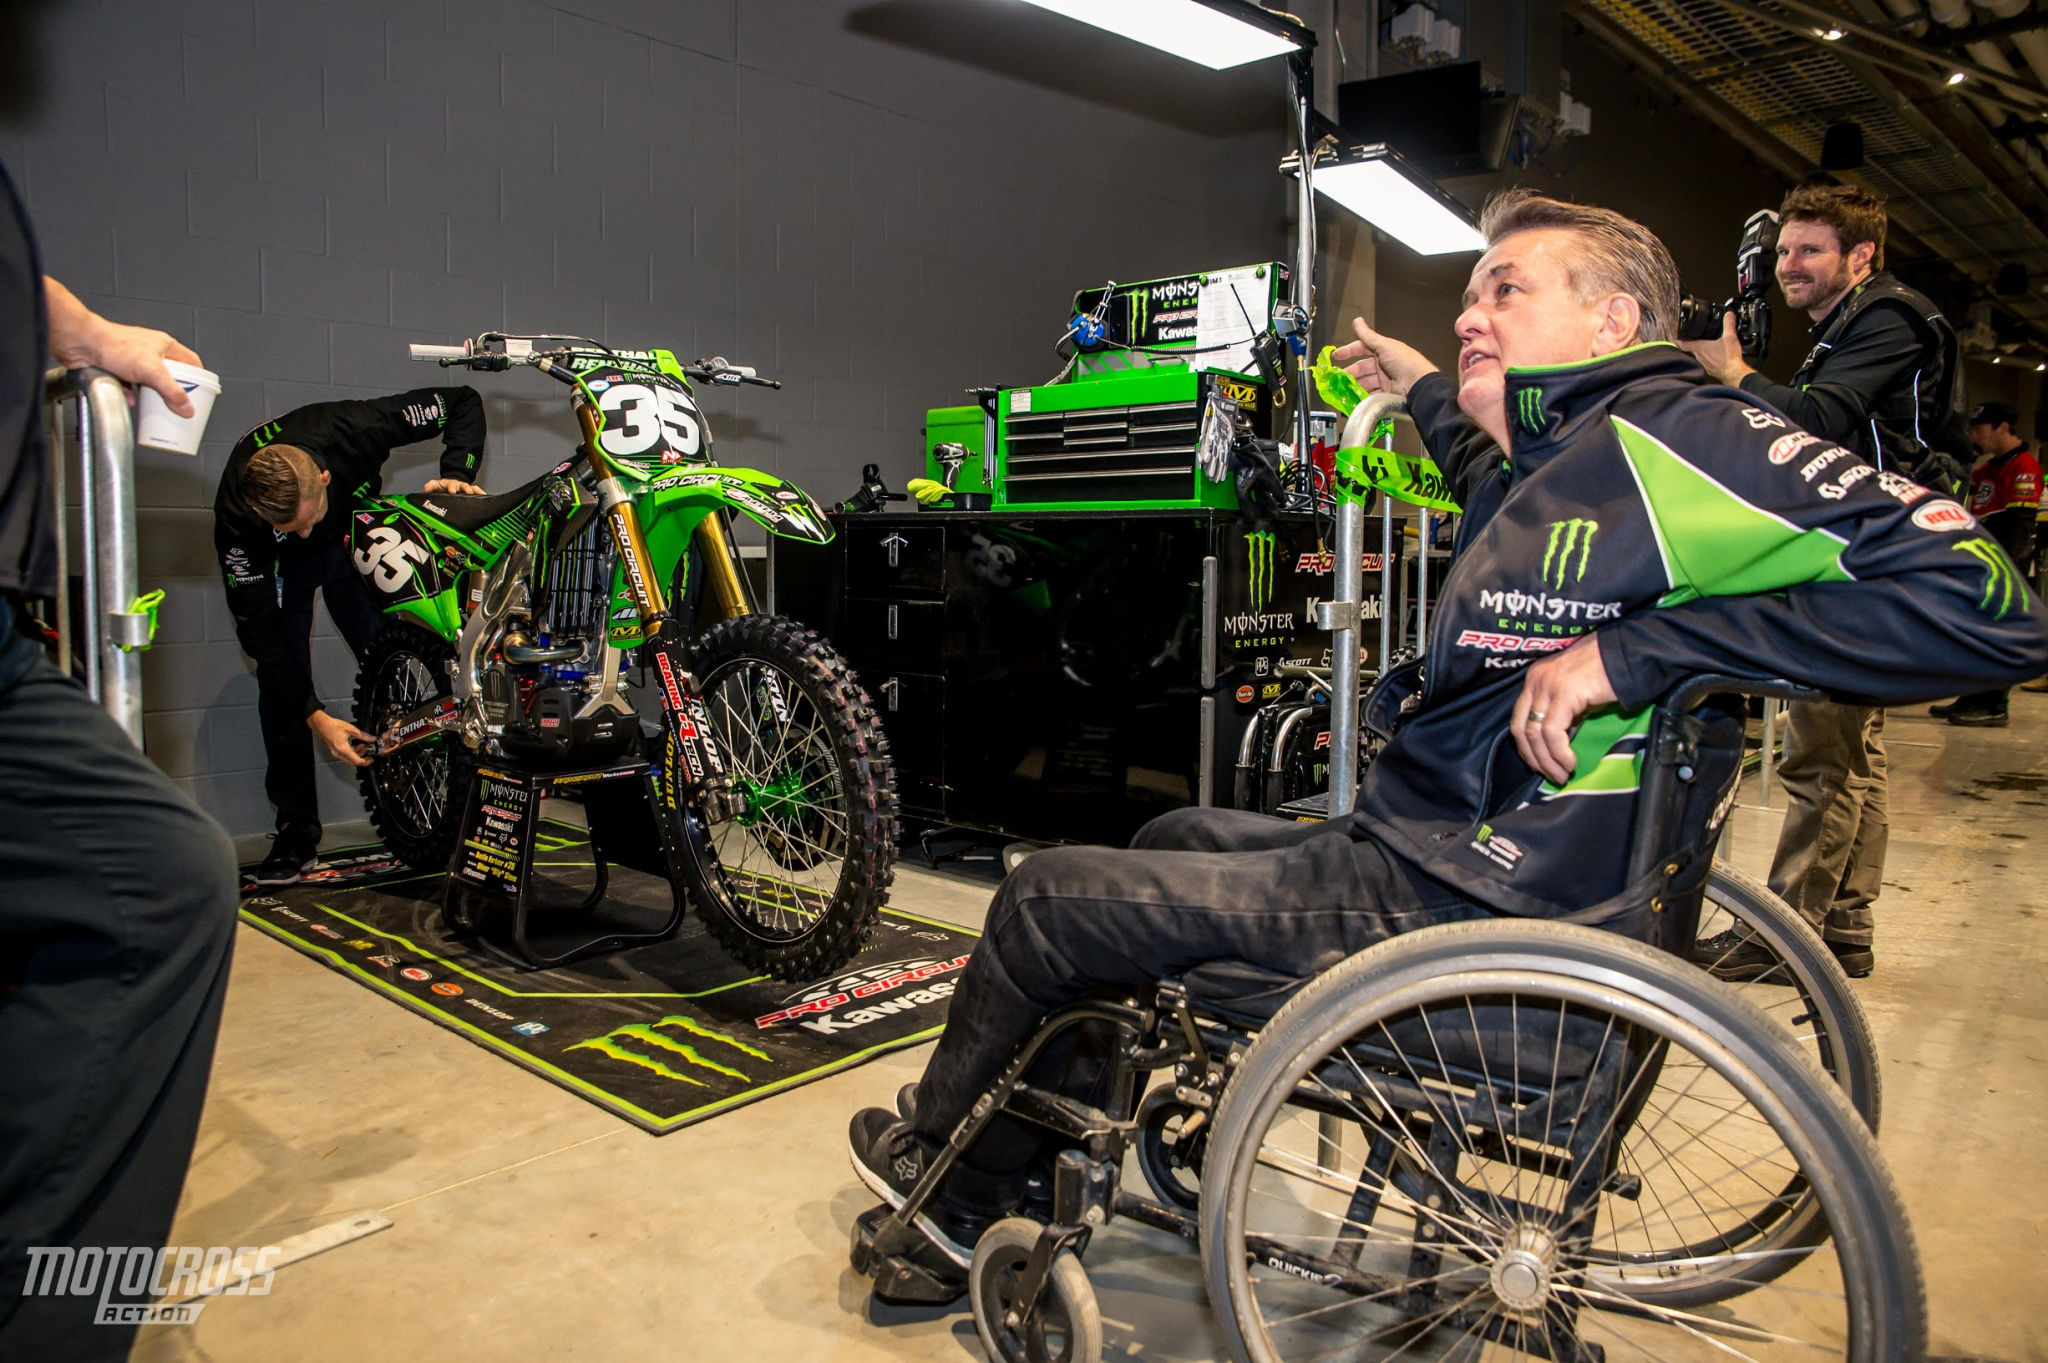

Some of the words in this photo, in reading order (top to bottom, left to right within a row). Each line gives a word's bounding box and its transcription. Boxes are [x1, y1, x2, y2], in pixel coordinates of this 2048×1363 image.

[1152, 279, 1200, 301] MONS
[1163, 297, 1198, 309] ENER
[1152, 311, 1179, 324] PRO
[1158, 325, 1198, 341] Kawas
[599, 384, 701, 456] 35
[653, 477, 678, 491] PRO
[679, 474, 744, 486] CIRCUIT
[422, 499, 448, 518] Kawasaki
[1923, 507, 1967, 525] BELL
[612, 512, 632, 546] PRO
[354, 527, 430, 593] 35
[1295, 552, 1336, 576] PRO
[625, 549, 652, 608] CIRCUIT
[1479, 589, 1622, 620] MONSTER
[1224, 611, 1295, 636] MONSTER
[1235, 636, 1285, 649] ENERGY
[1456, 630, 1523, 653] PRO
[1285, 657, 1312, 667] SCOTT
[656, 652, 684, 710] BRAKING
[493, 799, 523, 812] ENERGY
[485, 816, 514, 833] Kawasaki
[406, 969, 426, 980] BELL
[463, 998, 515, 1021] DUNLOP
[755, 992, 848, 1029] PRO
[800, 976, 958, 1035] Kawas
[1268, 1256, 1324, 1284] QUICKIE
